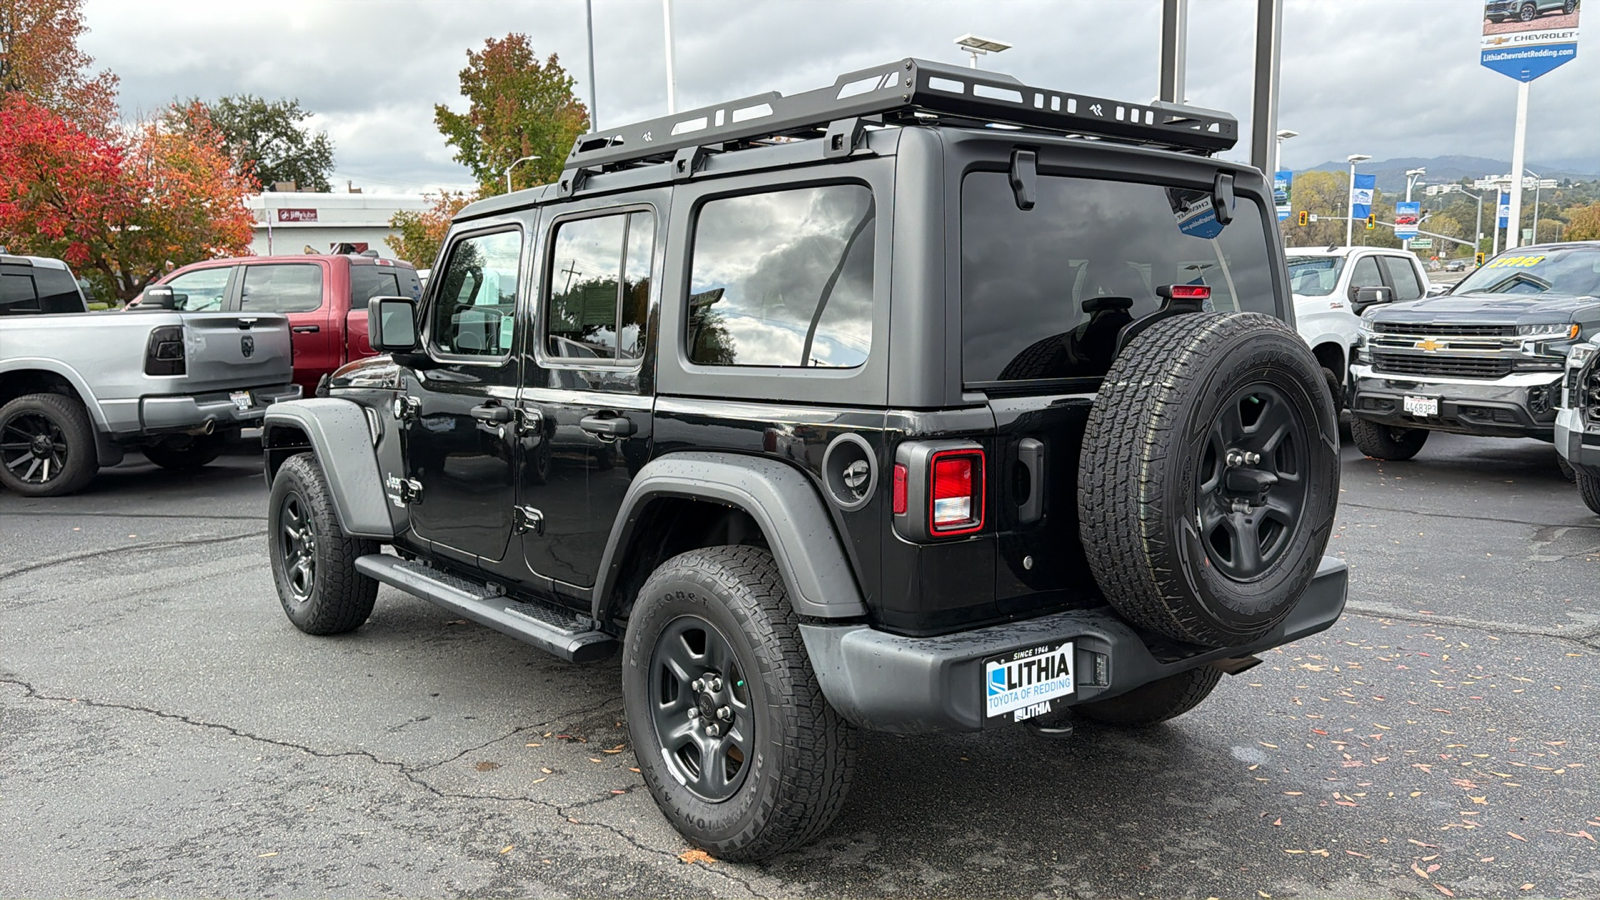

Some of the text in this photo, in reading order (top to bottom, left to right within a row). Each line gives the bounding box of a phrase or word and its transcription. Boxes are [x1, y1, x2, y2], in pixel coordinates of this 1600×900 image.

[1513, 31, 1575, 42] CHEVROLET
[1482, 48, 1574, 62] LithiaChevroletRedding.com
[1013, 645, 1049, 660] SINCE 1946
[1007, 652, 1070, 691] LITHIA
[988, 677, 1071, 709] TOYOTA OF REDDING
[1022, 700, 1052, 719] LITHIA
